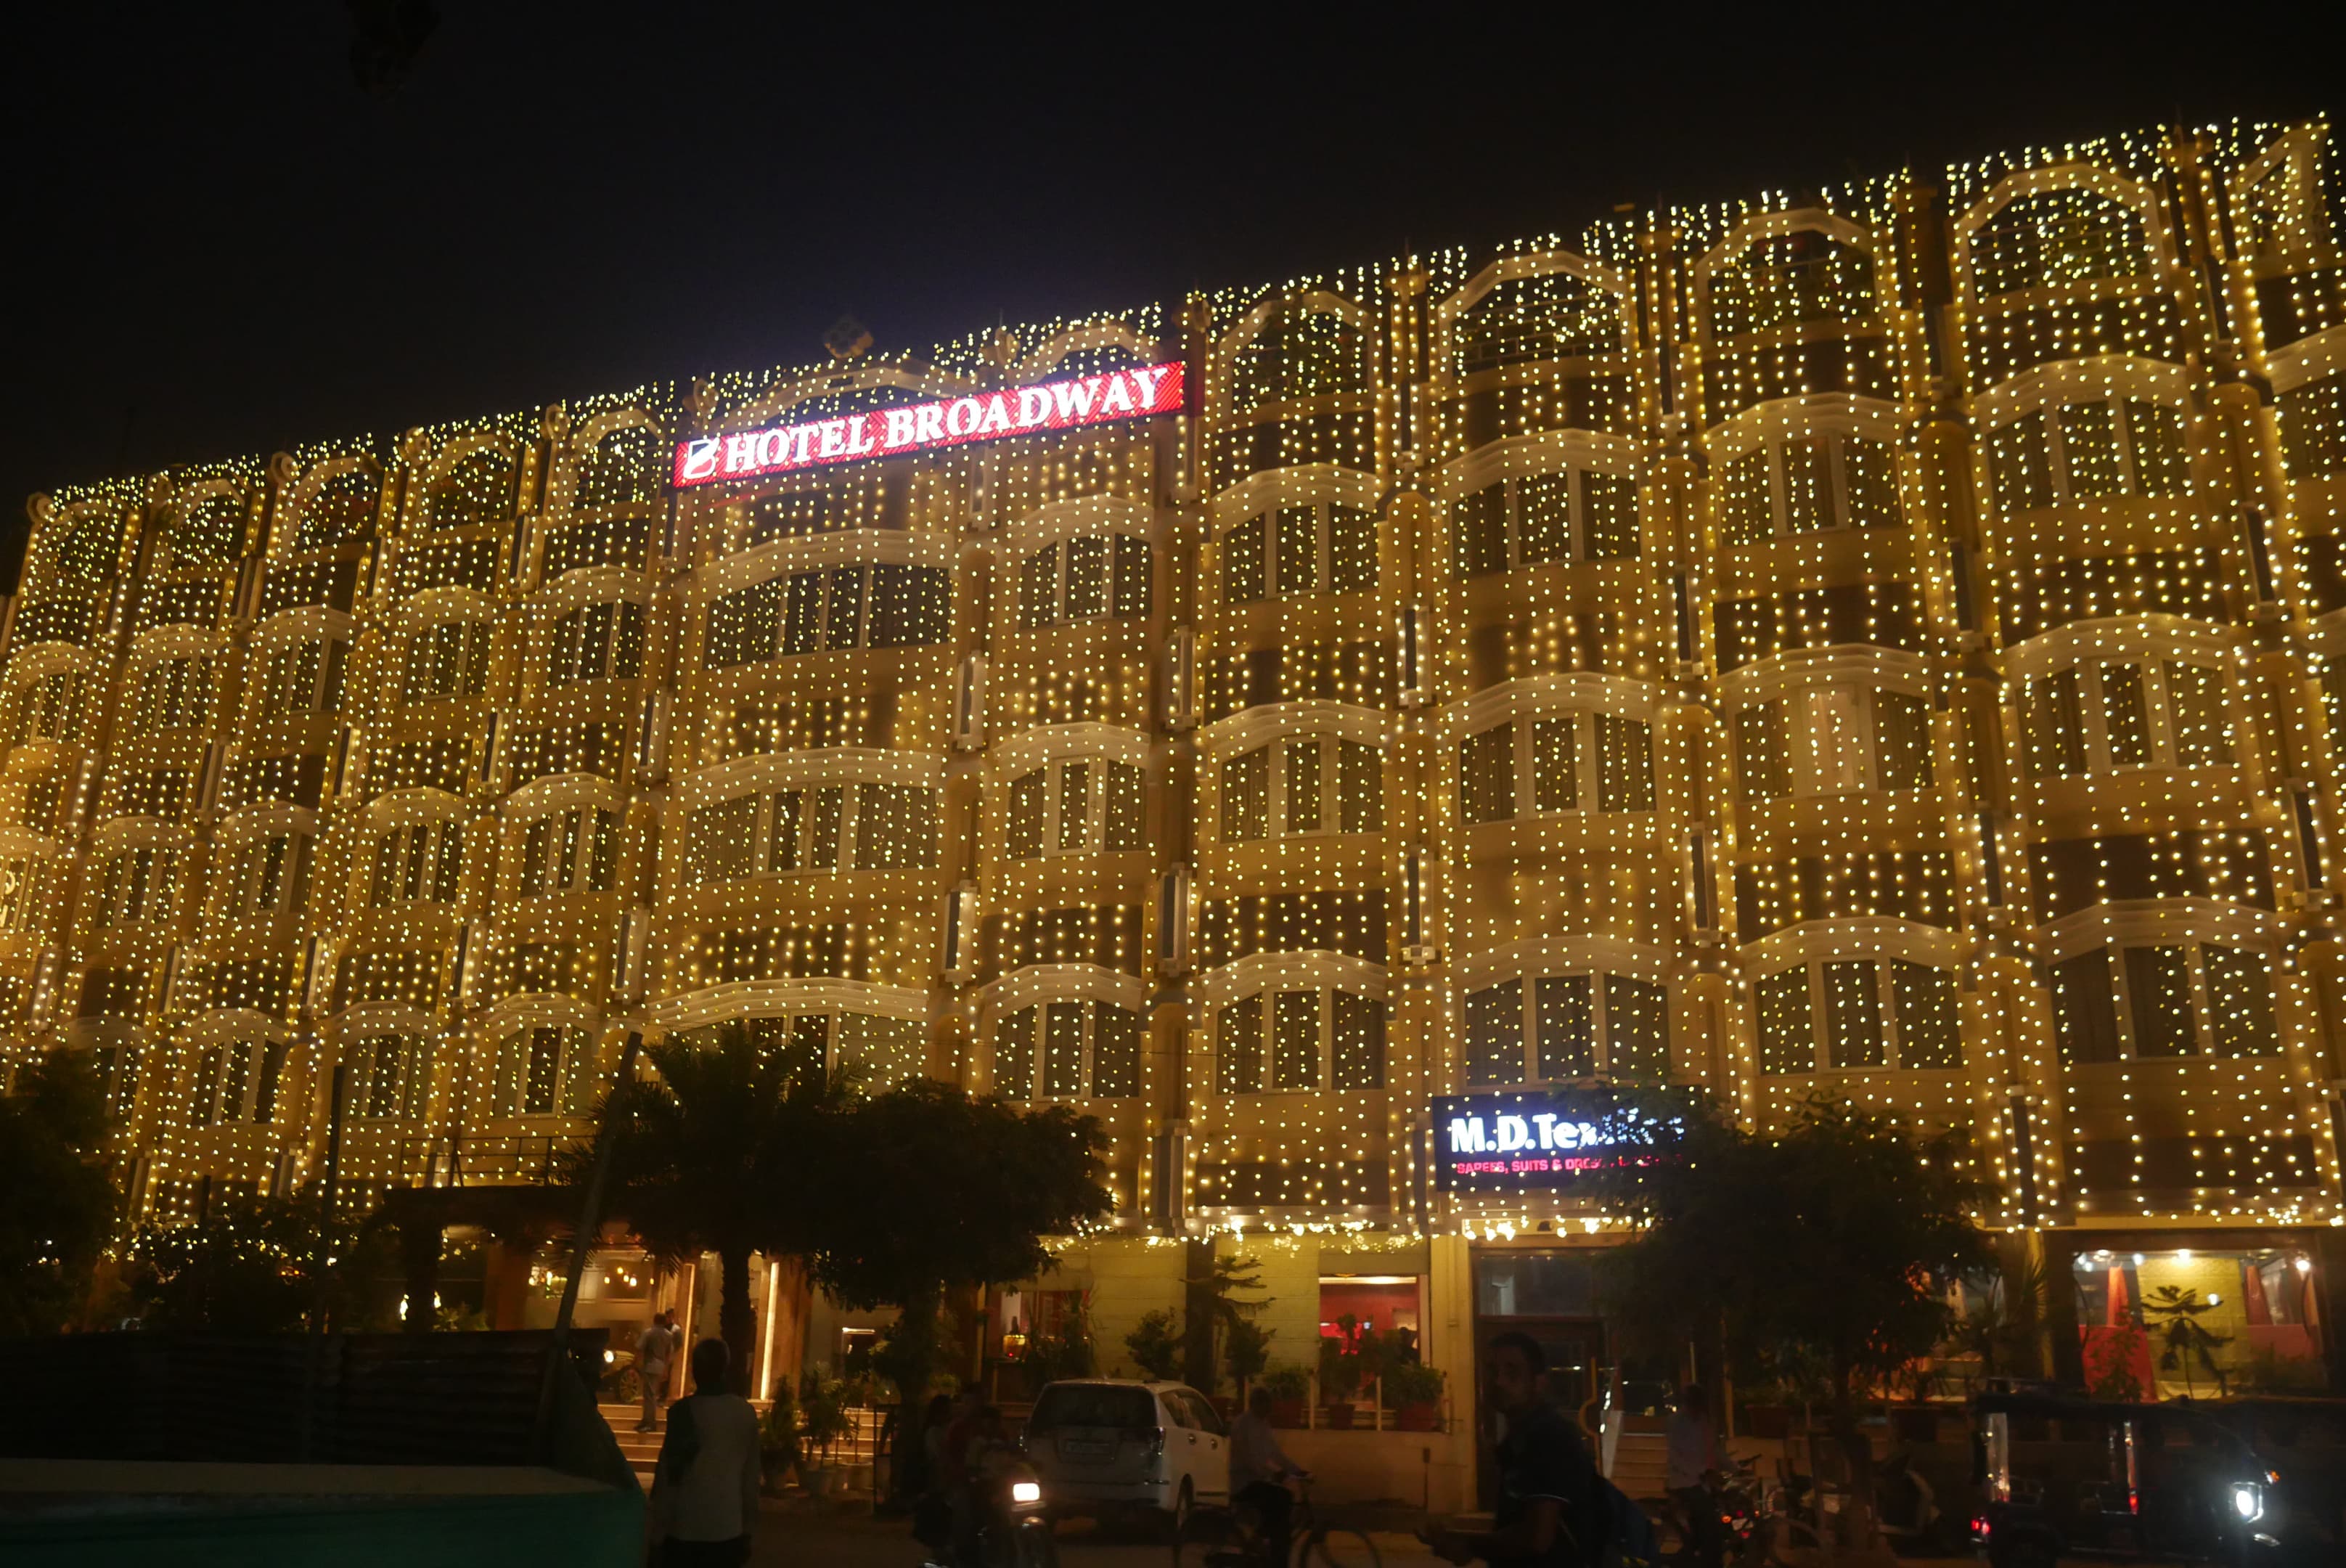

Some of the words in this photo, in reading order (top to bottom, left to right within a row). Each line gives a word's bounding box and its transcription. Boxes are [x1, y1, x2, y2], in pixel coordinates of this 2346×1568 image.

[726, 416, 875, 473] HOTEL
[883, 367, 1168, 449] BROADWAY
[1511, 1159, 1549, 1172] SUITS
